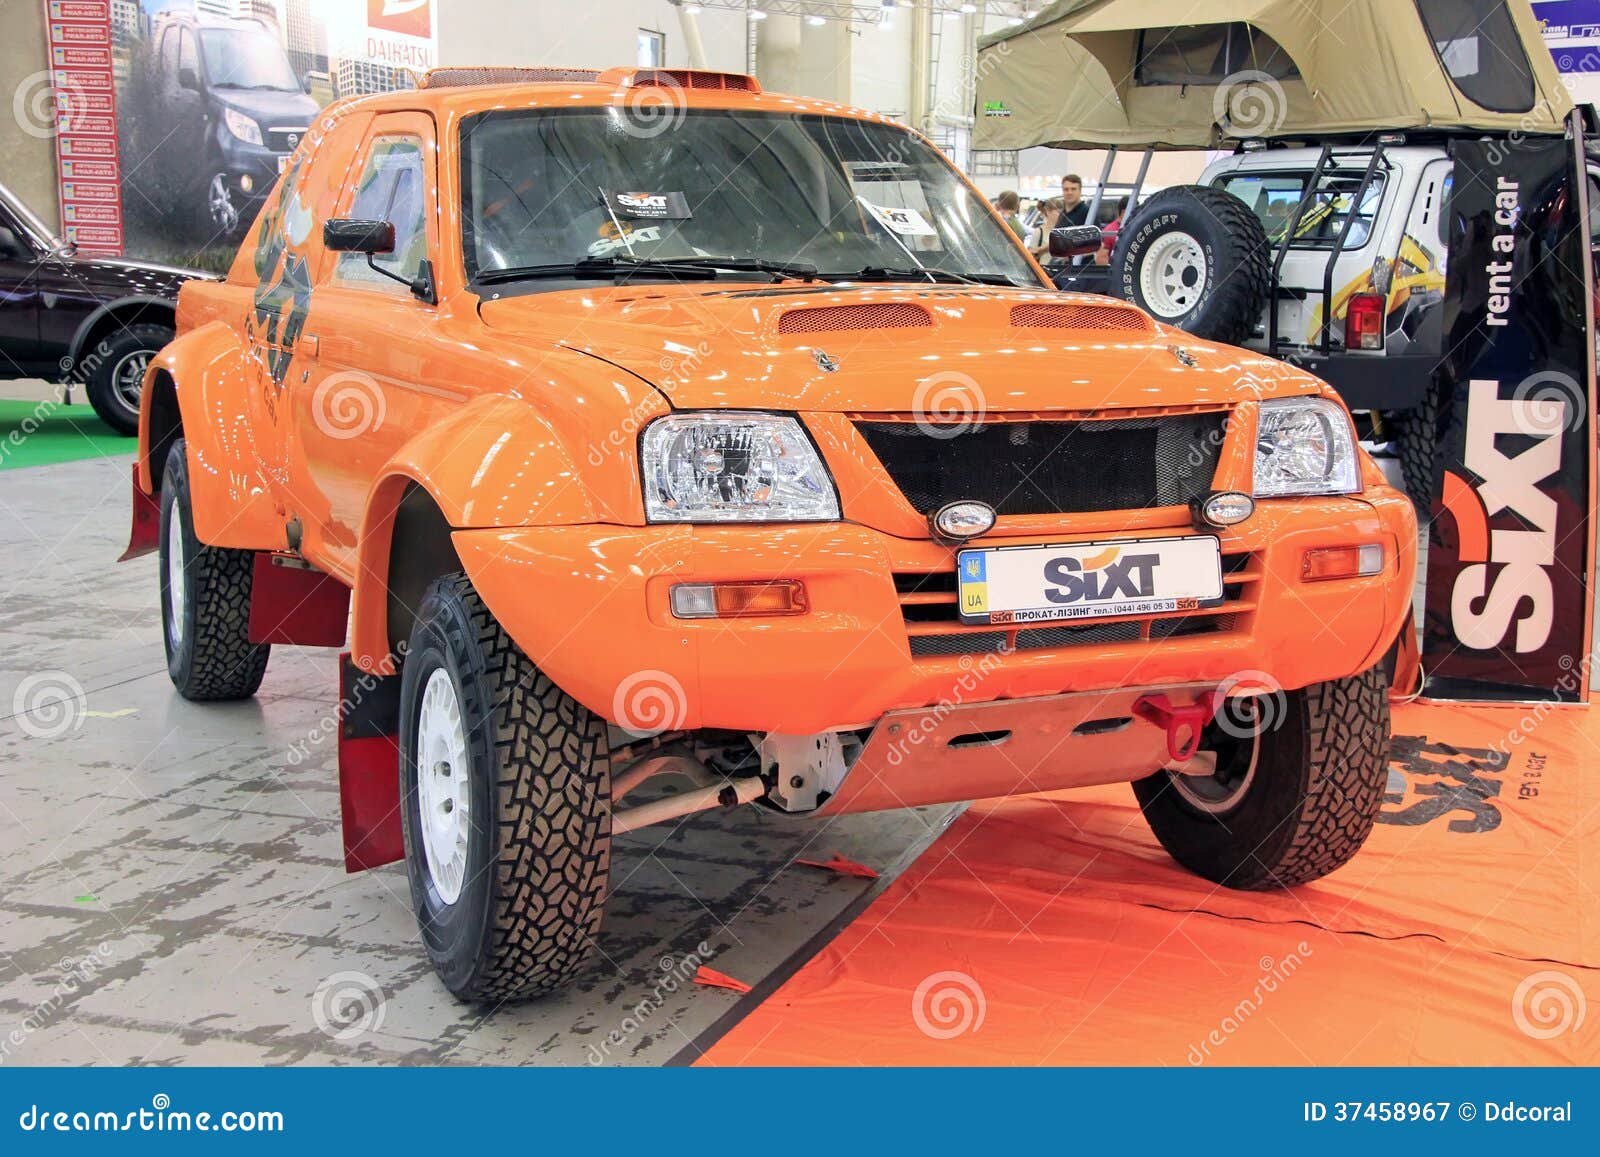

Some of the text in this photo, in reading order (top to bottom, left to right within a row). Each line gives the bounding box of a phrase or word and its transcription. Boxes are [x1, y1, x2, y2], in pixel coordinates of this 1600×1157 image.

[368, 38, 432, 68] DAIHATSU
[617, 193, 667, 206] SIXT
[1486, 176, 1519, 326] rent a car
[1442, 379, 1566, 653] SIXT
[1044, 547, 1161, 604] SIXT
[967, 594, 983, 607] UA
[1114, 604, 1135, 614] (044)
[1136, 603, 1151, 611] 496
[1153, 602, 1163, 610] 05
[1165, 601, 1175, 610] 30
